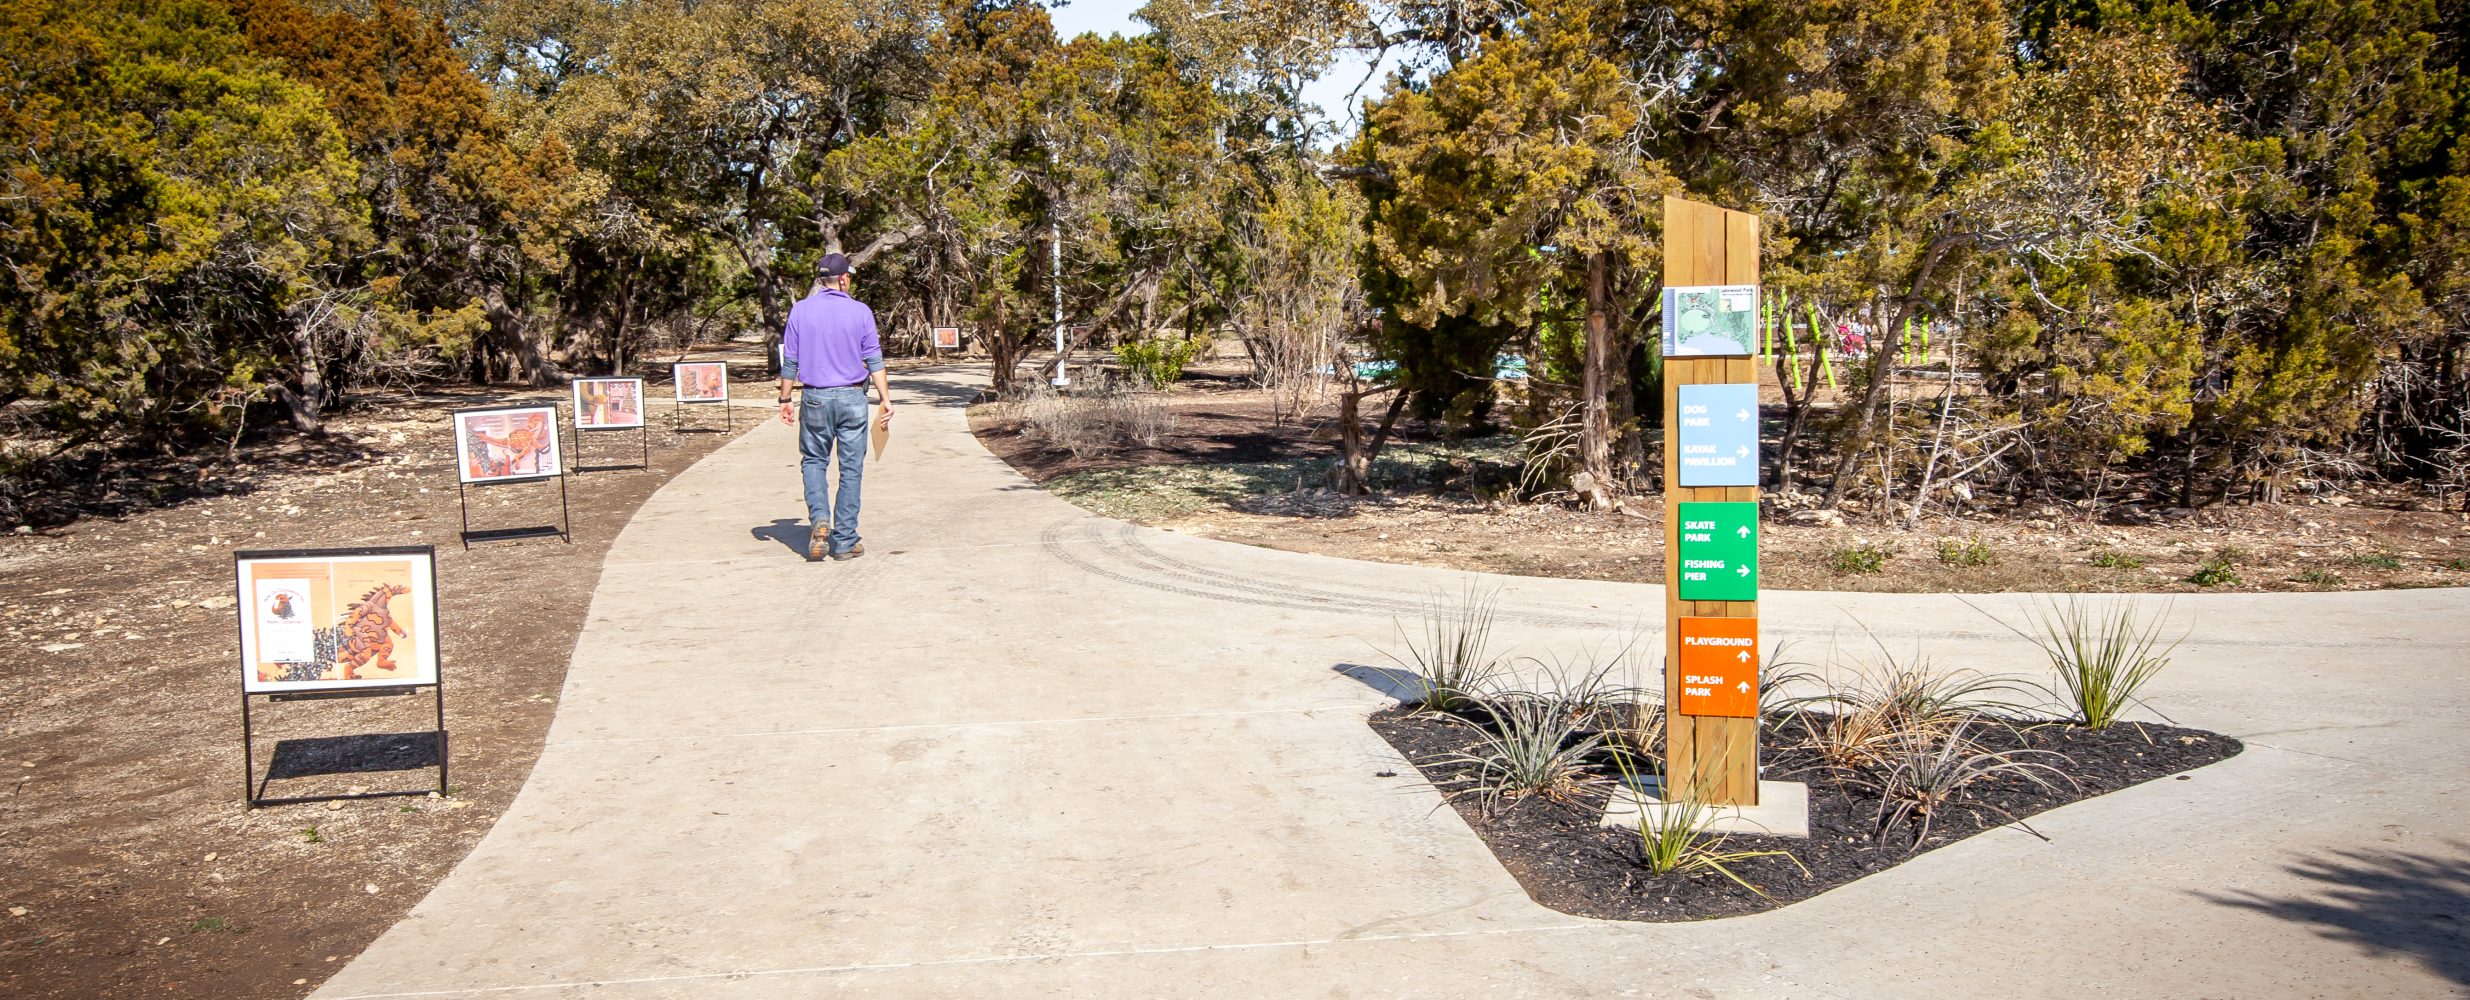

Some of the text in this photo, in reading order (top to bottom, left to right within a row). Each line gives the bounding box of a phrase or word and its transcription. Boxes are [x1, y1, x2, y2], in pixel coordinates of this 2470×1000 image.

[1684, 405, 1707, 414] DOG
[1684, 418, 1710, 426] PARK
[1684, 445, 1717, 453] KAYAK
[1684, 457, 1736, 466] PAVILLION
[1684, 521, 1716, 529] SKATE
[1684, 533, 1711, 542] PARK
[1684, 560, 1725, 568] FISHING
[1684, 572, 1706, 580] PIER
[1685, 637, 1753, 646] PLAYGROUND
[1685, 675, 1723, 684] SPLASH
[1685, 687, 1711, 696] PARK
